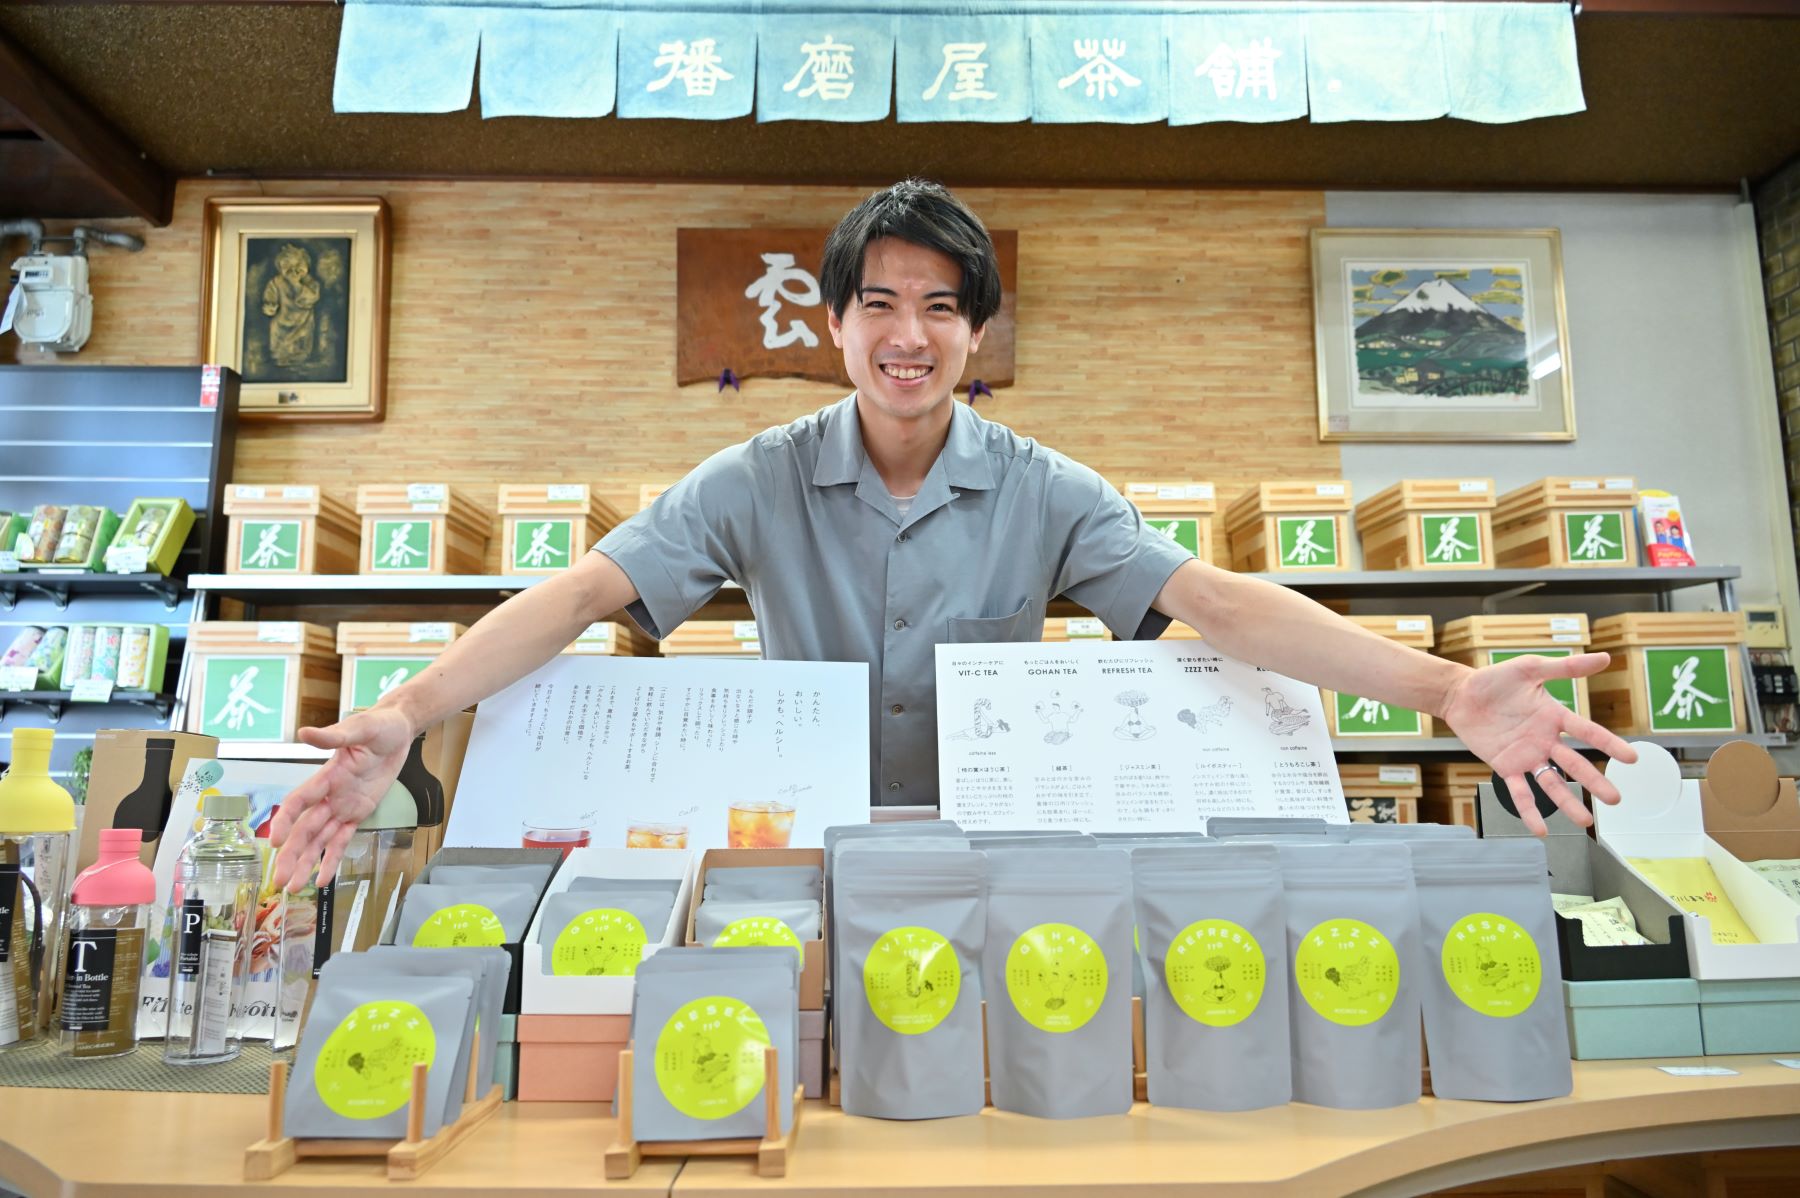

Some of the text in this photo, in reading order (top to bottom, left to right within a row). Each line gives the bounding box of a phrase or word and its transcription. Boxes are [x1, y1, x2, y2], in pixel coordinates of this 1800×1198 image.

[243, 522, 296, 568] 茶
[375, 521, 428, 568] 茶
[516, 520, 569, 567] 茶
[1285, 519, 1333, 565] 茶
[1425, 515, 1478, 562] 茶
[1569, 513, 1622, 560] 茶
[205, 665, 279, 731] 茶
[1653, 655, 1728, 722] 茶
[183, 913, 201, 934] P
[1176, 926, 1253, 955] REFRESH
[1313, 927, 1380, 948] ZZZZ
[72, 940, 98, 973] T
[84, 973, 109, 982] Bottle
[346, 1007, 420, 1032] ZZZZ
